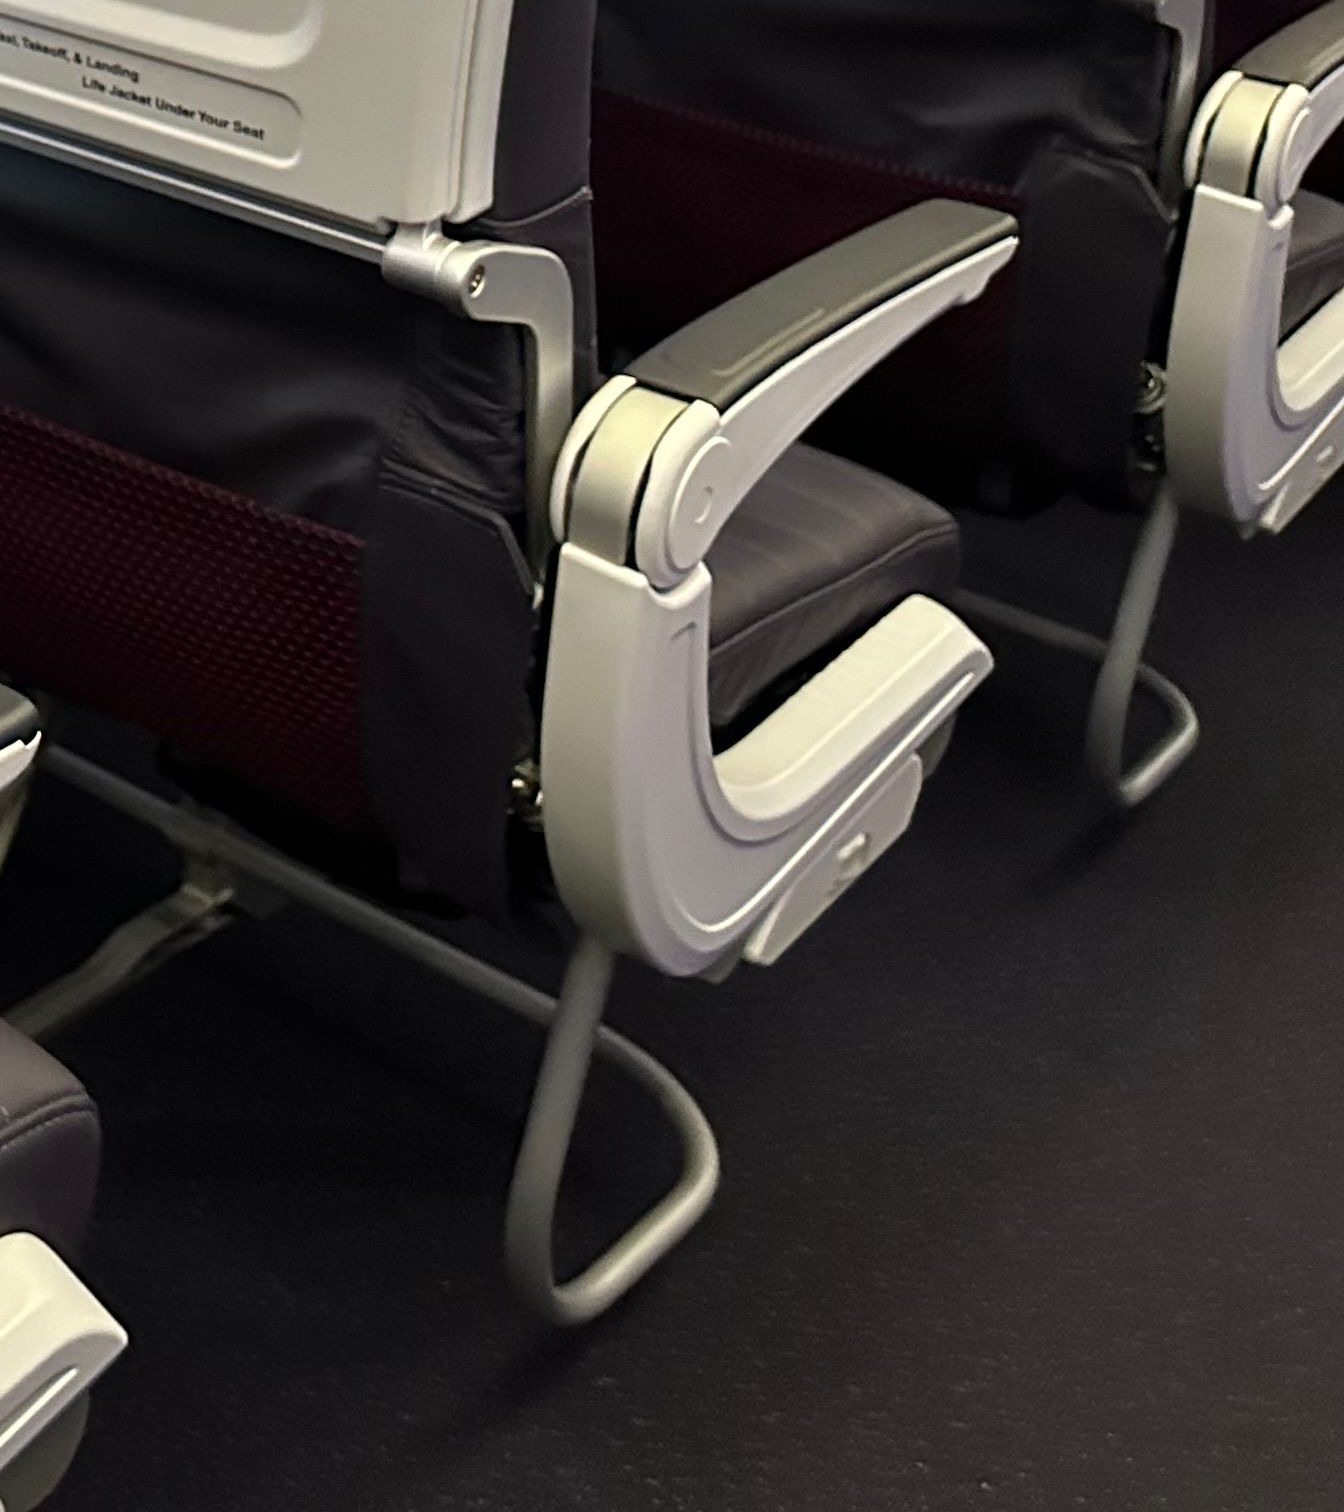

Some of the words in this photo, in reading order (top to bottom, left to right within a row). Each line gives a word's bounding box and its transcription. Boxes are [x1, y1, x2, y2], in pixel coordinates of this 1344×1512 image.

[85, 55, 140, 84] Landing
[81, 75, 106, 93] Life
[108, 84, 152, 107] Jacket
[154, 96, 196, 120] Under
[197, 108, 230, 129] Your
[232, 119, 266, 140] Seat
